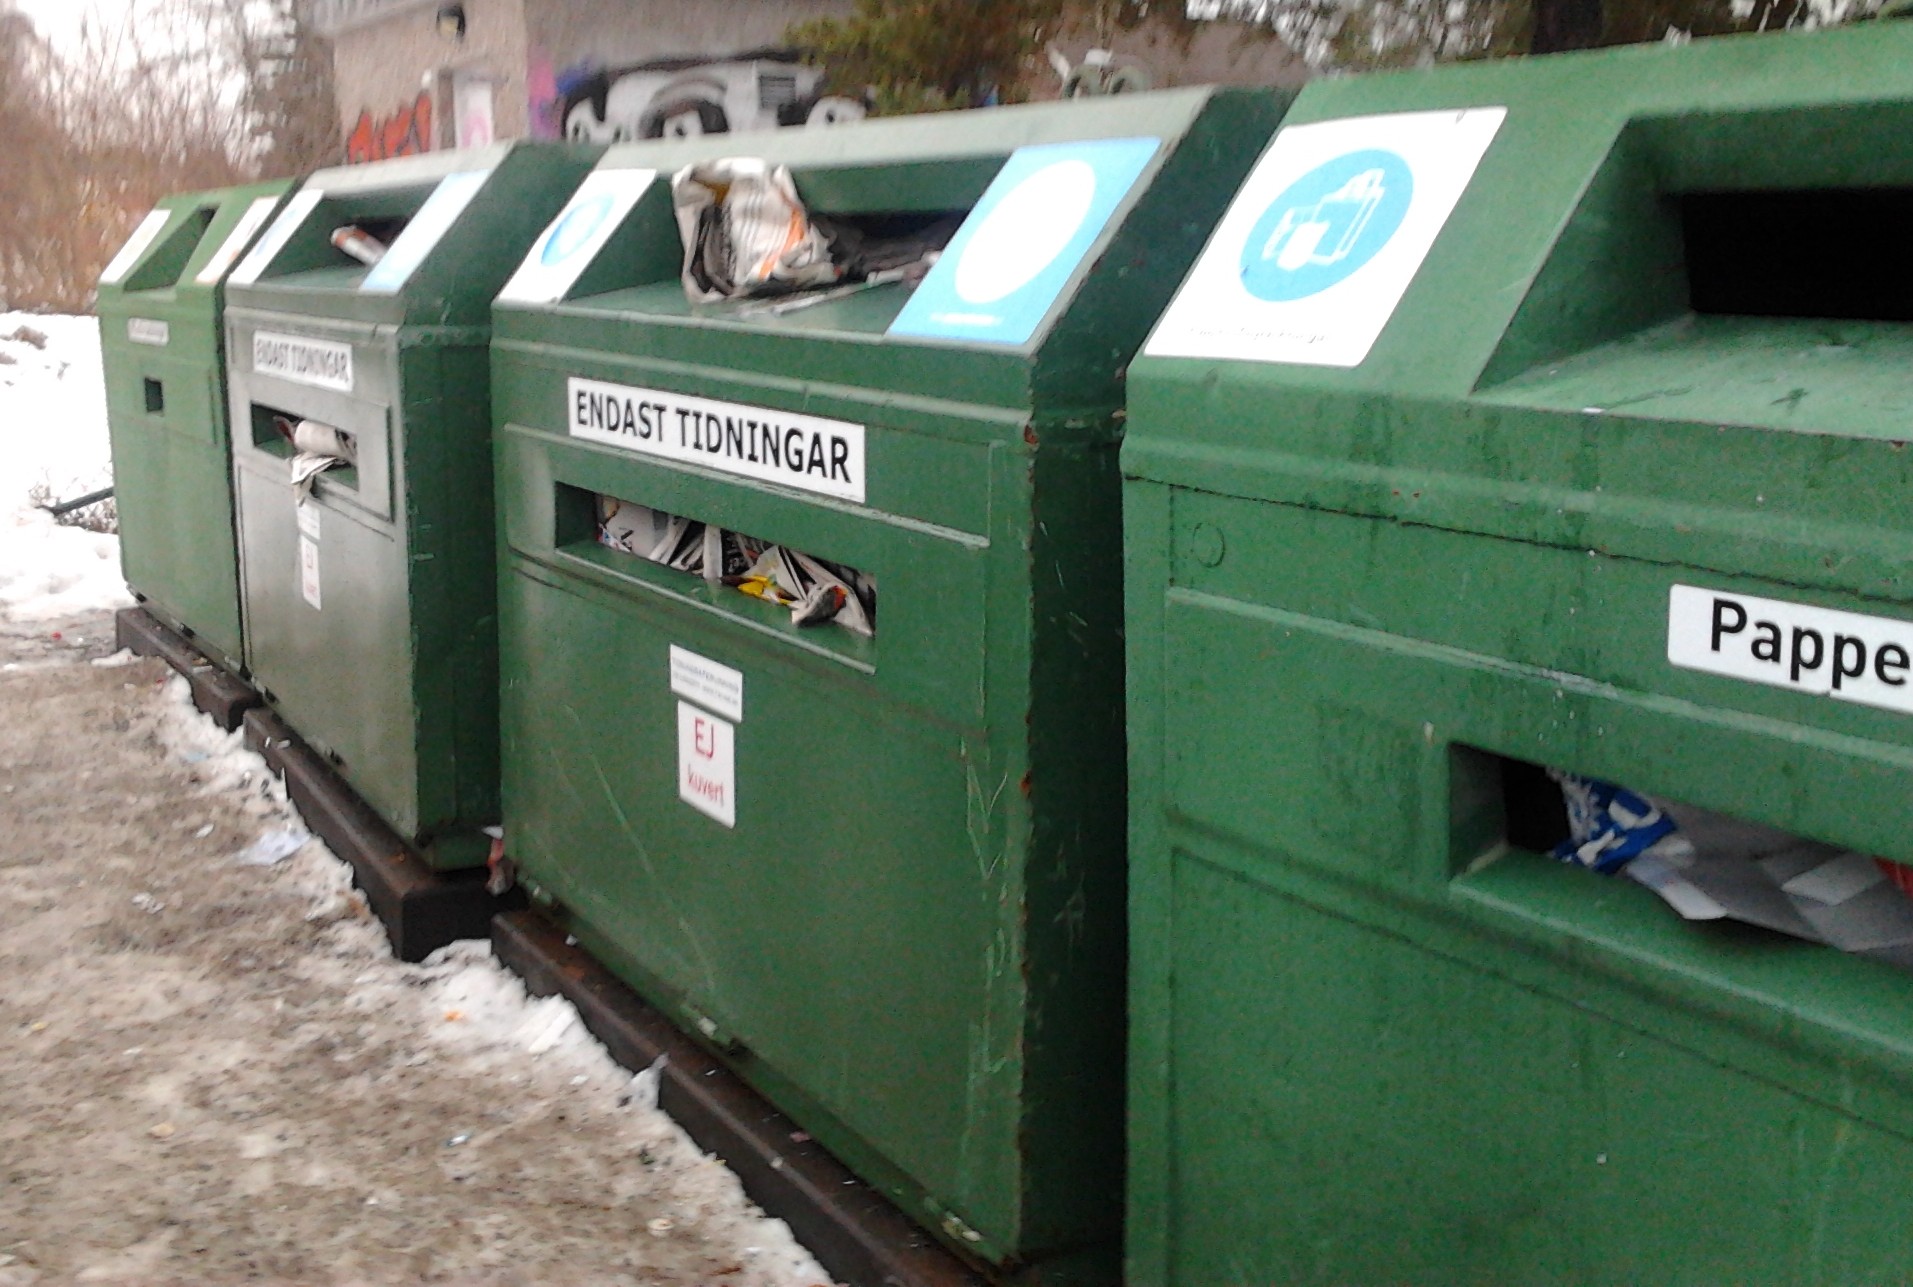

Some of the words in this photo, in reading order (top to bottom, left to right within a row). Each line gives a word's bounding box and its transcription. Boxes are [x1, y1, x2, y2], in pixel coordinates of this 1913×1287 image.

[576, 389, 666, 442] ENDAST
[676, 407, 852, 483] TIDNINGAR
[1711, 597, 1911, 690] Pappe
[694, 715, 714, 759] EJ
